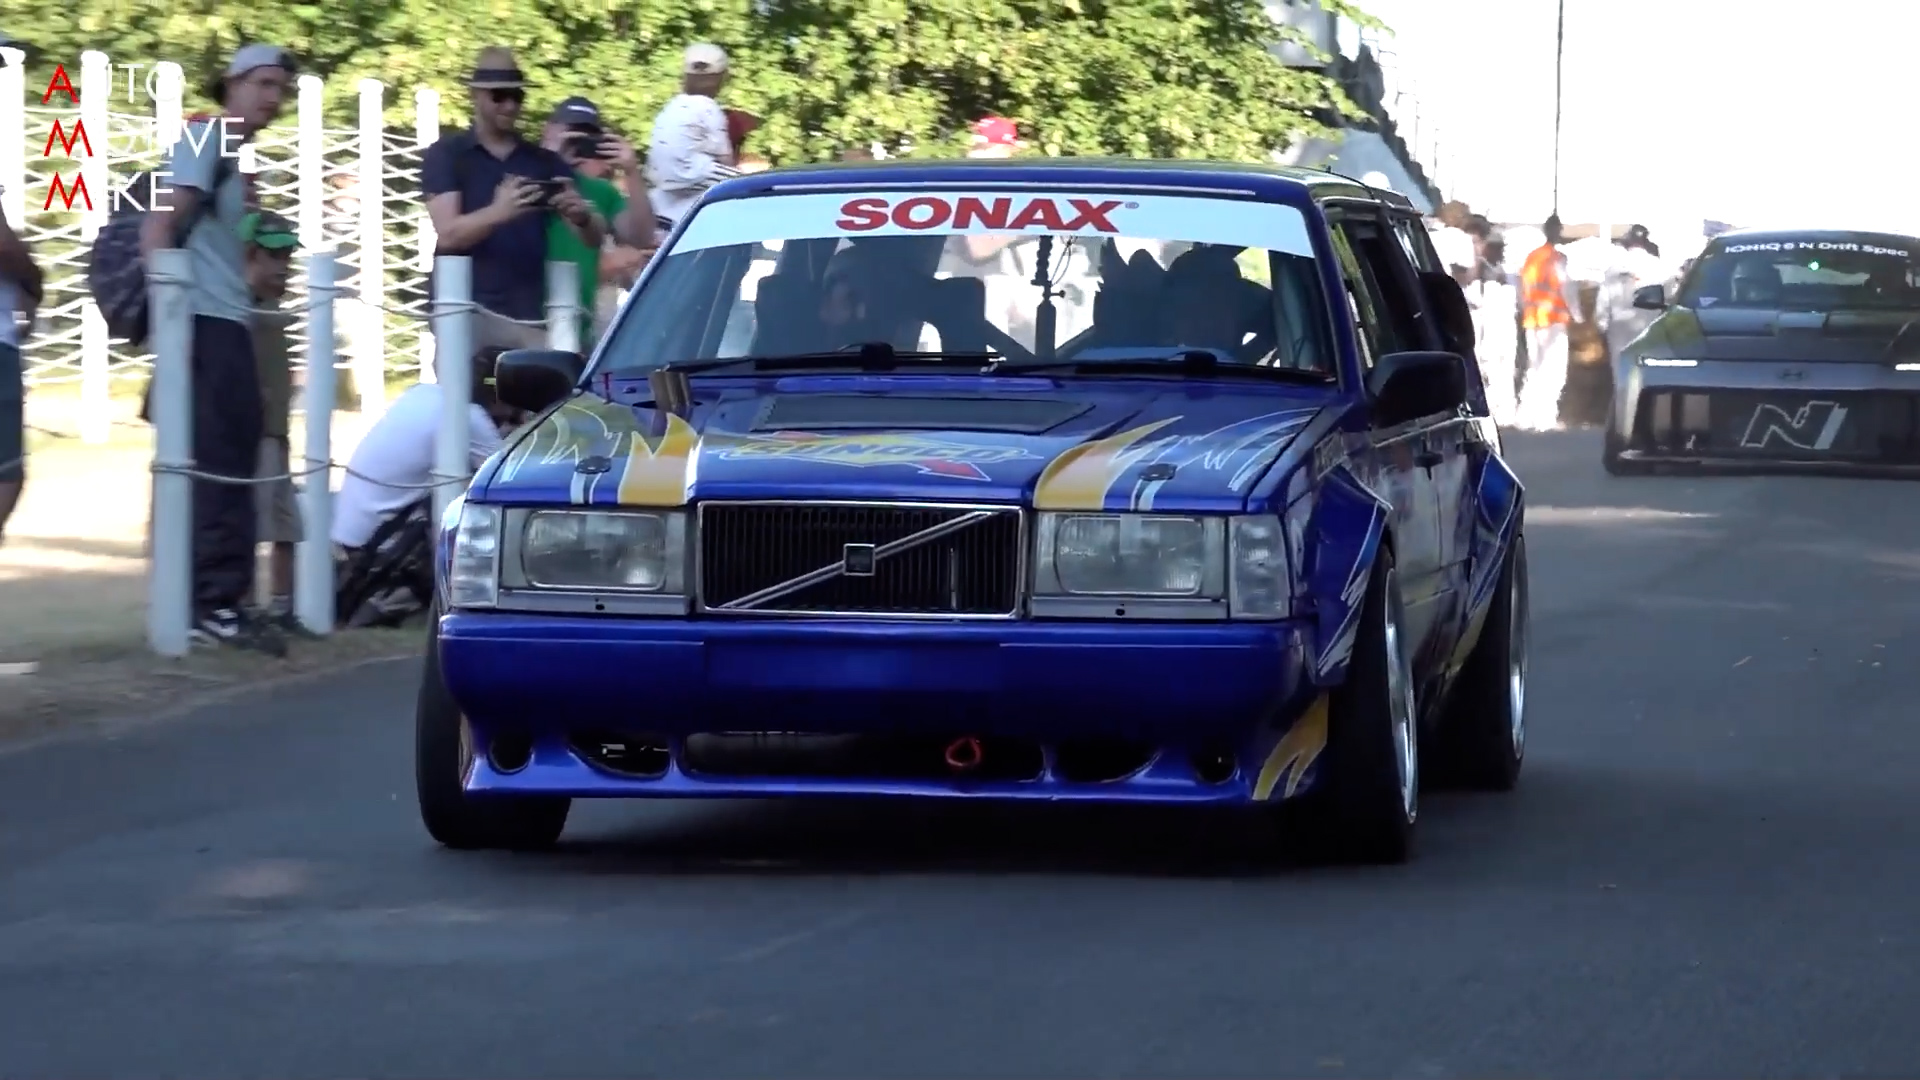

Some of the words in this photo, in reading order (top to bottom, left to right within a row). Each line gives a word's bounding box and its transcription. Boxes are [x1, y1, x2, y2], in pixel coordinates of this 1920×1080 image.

[835, 197, 1123, 233] SONAX
[1724, 242, 1780, 254] IONIQ
[1799, 241, 1815, 249] N
[1818, 242, 1859, 252] Drift
[1862, 244, 1909, 257] Spec
